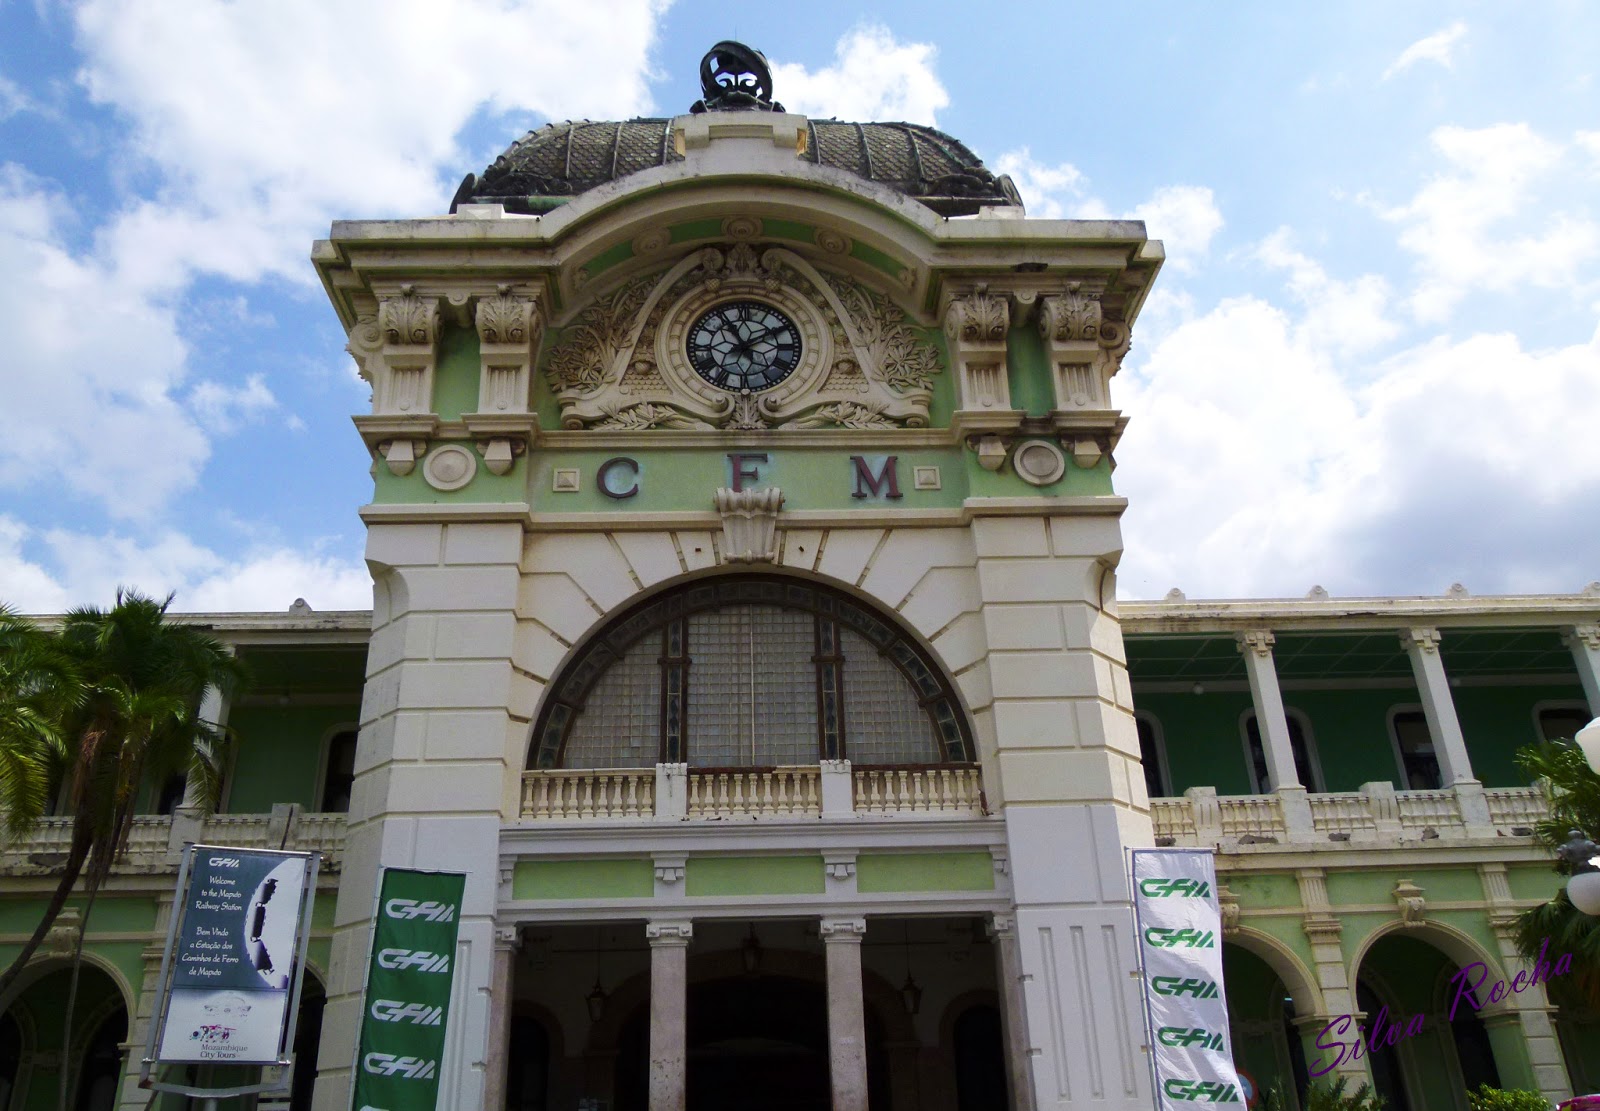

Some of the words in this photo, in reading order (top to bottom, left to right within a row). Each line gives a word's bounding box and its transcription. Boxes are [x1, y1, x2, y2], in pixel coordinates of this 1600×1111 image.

[209, 875, 236, 885] Welcome
[1139, 878, 1211, 898] CFM
[201, 889, 208, 897] to
[208, 888, 218, 898] the
[218, 889, 242, 900] Maputo
[195, 900, 220, 912] Railway
[220, 901, 242, 911] Station
[385, 898, 454, 922] CFM
[196, 926, 211, 936] Bem
[211, 927, 229, 937] Vindo
[1145, 927, 1214, 948] CFM
[195, 940, 221, 950] Estação
[221, 941, 233, 950] dos
[181, 952, 212, 963] Caminhos
[212, 953, 221, 963] de
[221, 954, 239, 964] Ferro
[378, 948, 449, 973] CFM
[188, 966, 197, 976] de
[197, 966, 222, 978] Maputo
[1151, 975, 1219, 999] CFM
[371, 999, 442, 1026] CFM
[1157, 1026, 1224, 1052] CFM
[200, 1050, 215, 1060] City
[216, 1050, 236, 1059] Tours
[201, 1043, 248, 1052] Mozambique
[363, 1052, 436, 1080] CFM
[1163, 1078, 1240, 1103] CFM
